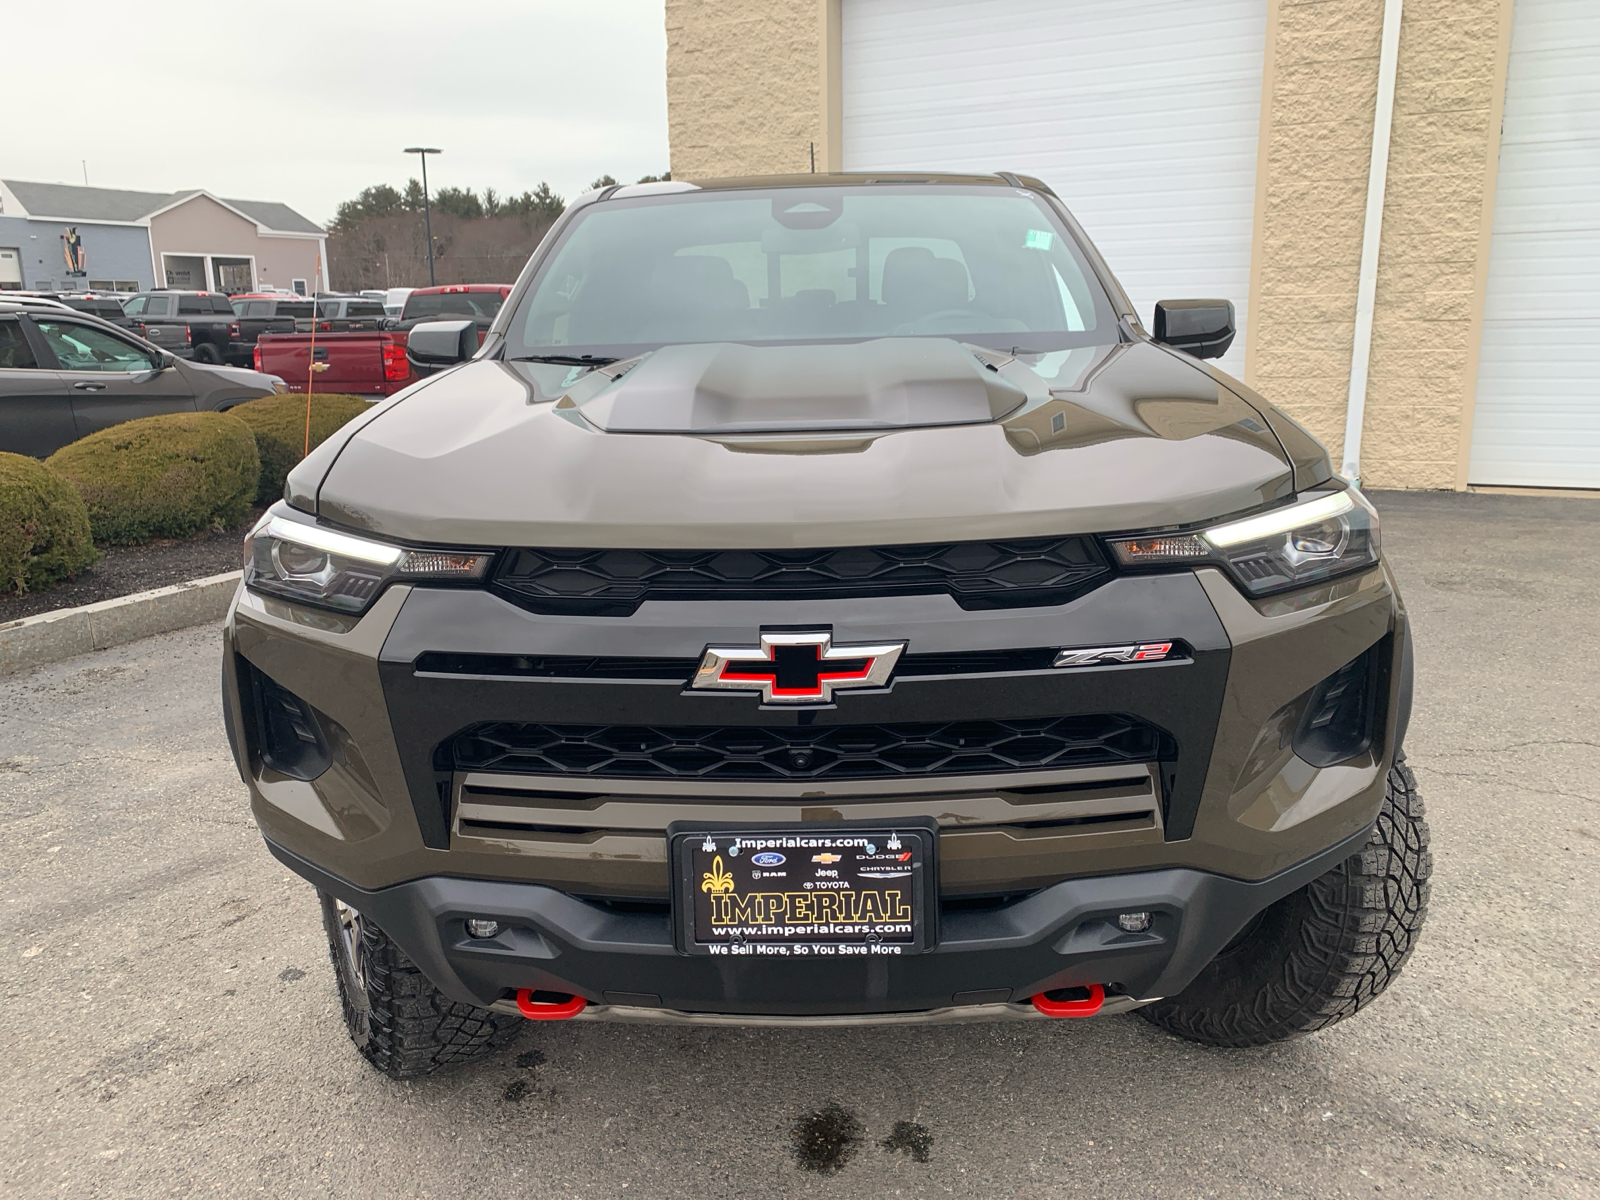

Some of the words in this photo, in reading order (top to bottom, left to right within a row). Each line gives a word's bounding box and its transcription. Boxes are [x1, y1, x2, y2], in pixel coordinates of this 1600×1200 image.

[1053, 642, 1172, 667] ZR2
[735, 837, 868, 849] Imperialcars.com
[815, 868, 838, 878] Jeep
[815, 881, 850, 889] TOYOTA
[711, 890, 911, 925] IMPERIAL
[712, 923, 912, 936] www.imperialcars.com
[708, 945, 728, 954] We
[731, 945, 752, 954] Sell
[756, 945, 790, 956] More,
[793, 945, 808, 954] So
[812, 944, 835, 954] You
[838, 944, 867, 954] Save
[871, 944, 901, 954] More
